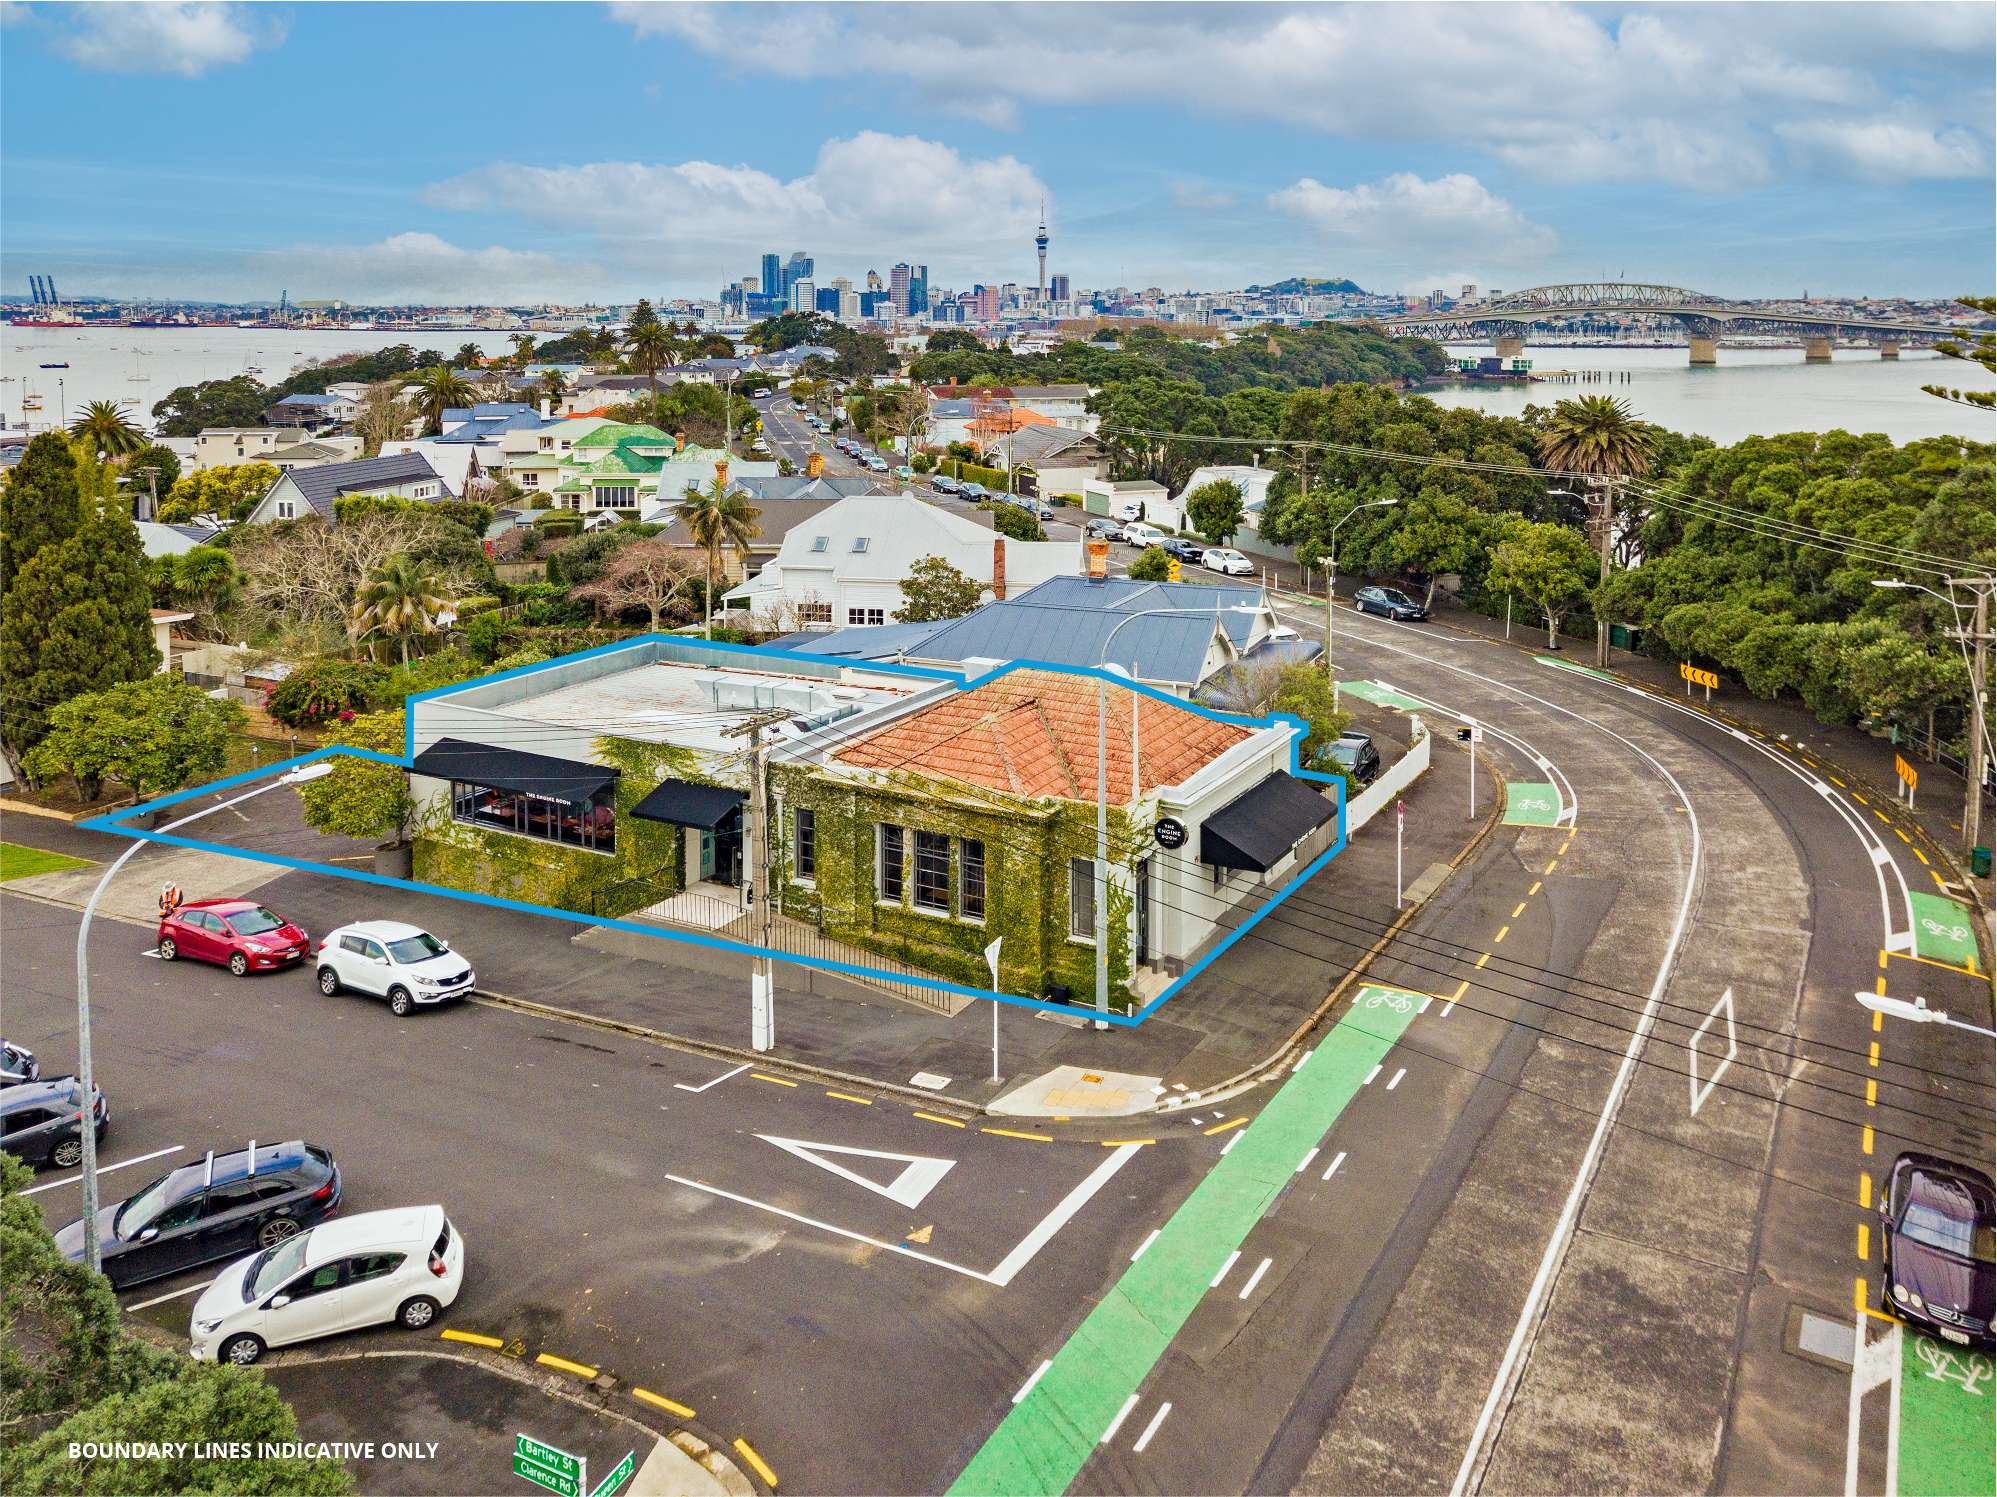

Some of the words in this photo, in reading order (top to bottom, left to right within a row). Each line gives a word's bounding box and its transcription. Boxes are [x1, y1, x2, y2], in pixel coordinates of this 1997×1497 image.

[525, 791, 535, 799] THE
[1157, 827, 1181, 837] ENGINE
[525, 1441, 559, 1468] Bartley
[562, 1457, 574, 1473] St
[520, 1461, 557, 1487] Clarence
[559, 1478, 571, 1493] Rd
[594, 1477, 617, 1497] ueen
[618, 1465, 627, 1481] St
